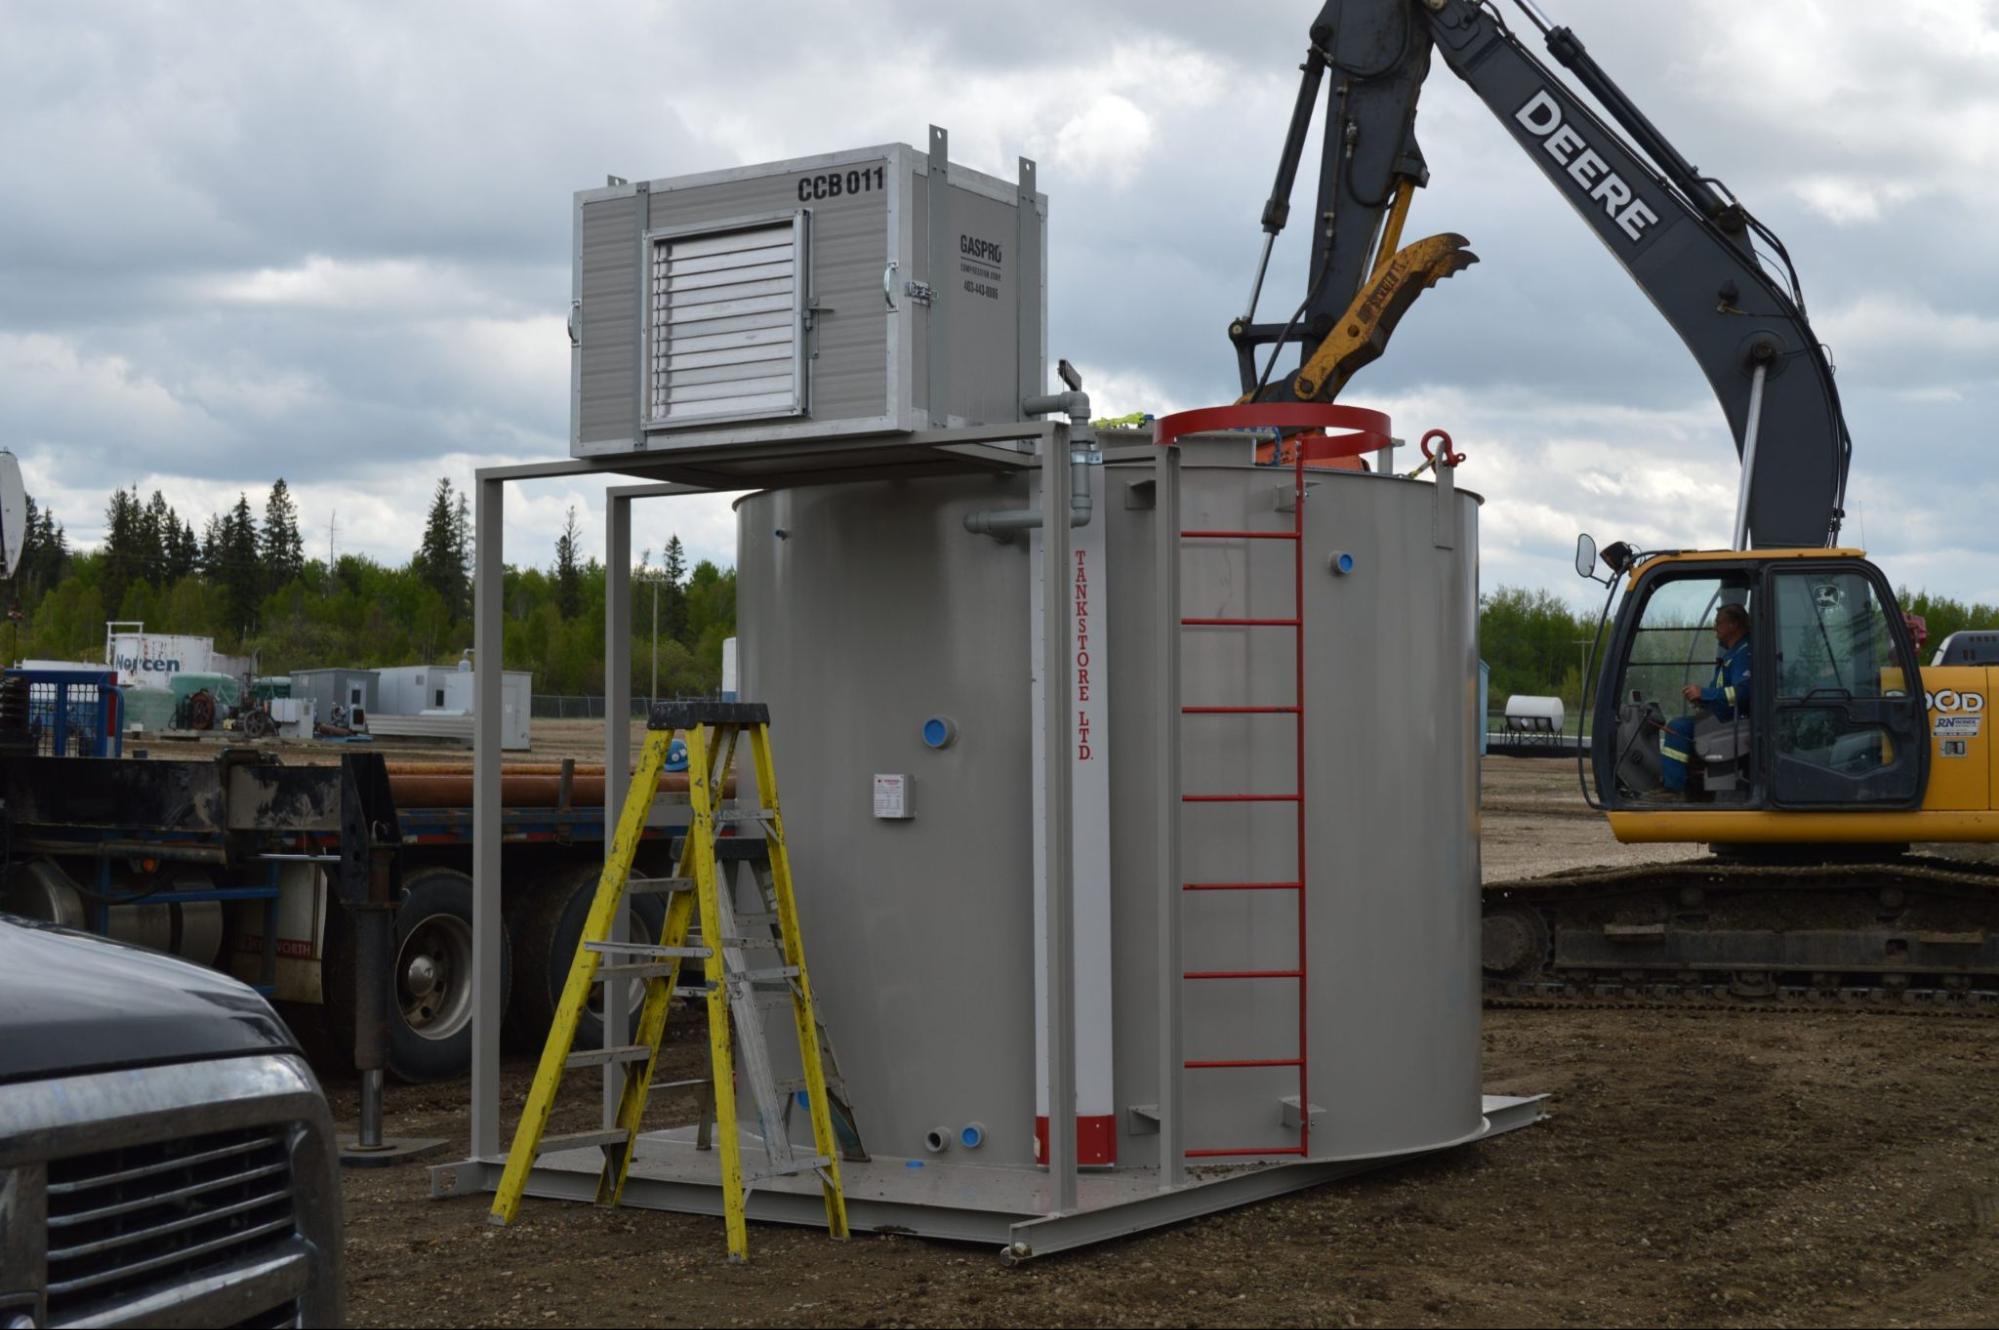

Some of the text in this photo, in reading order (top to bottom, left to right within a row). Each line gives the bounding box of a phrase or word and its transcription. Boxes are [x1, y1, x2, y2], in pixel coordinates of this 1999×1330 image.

[798, 166, 883, 202] CCB 011
[1515, 89, 1659, 241] DEERE
[960, 234, 1002, 264] GASPRO
[1075, 550, 1094, 760] TANKSTORE LTD.
